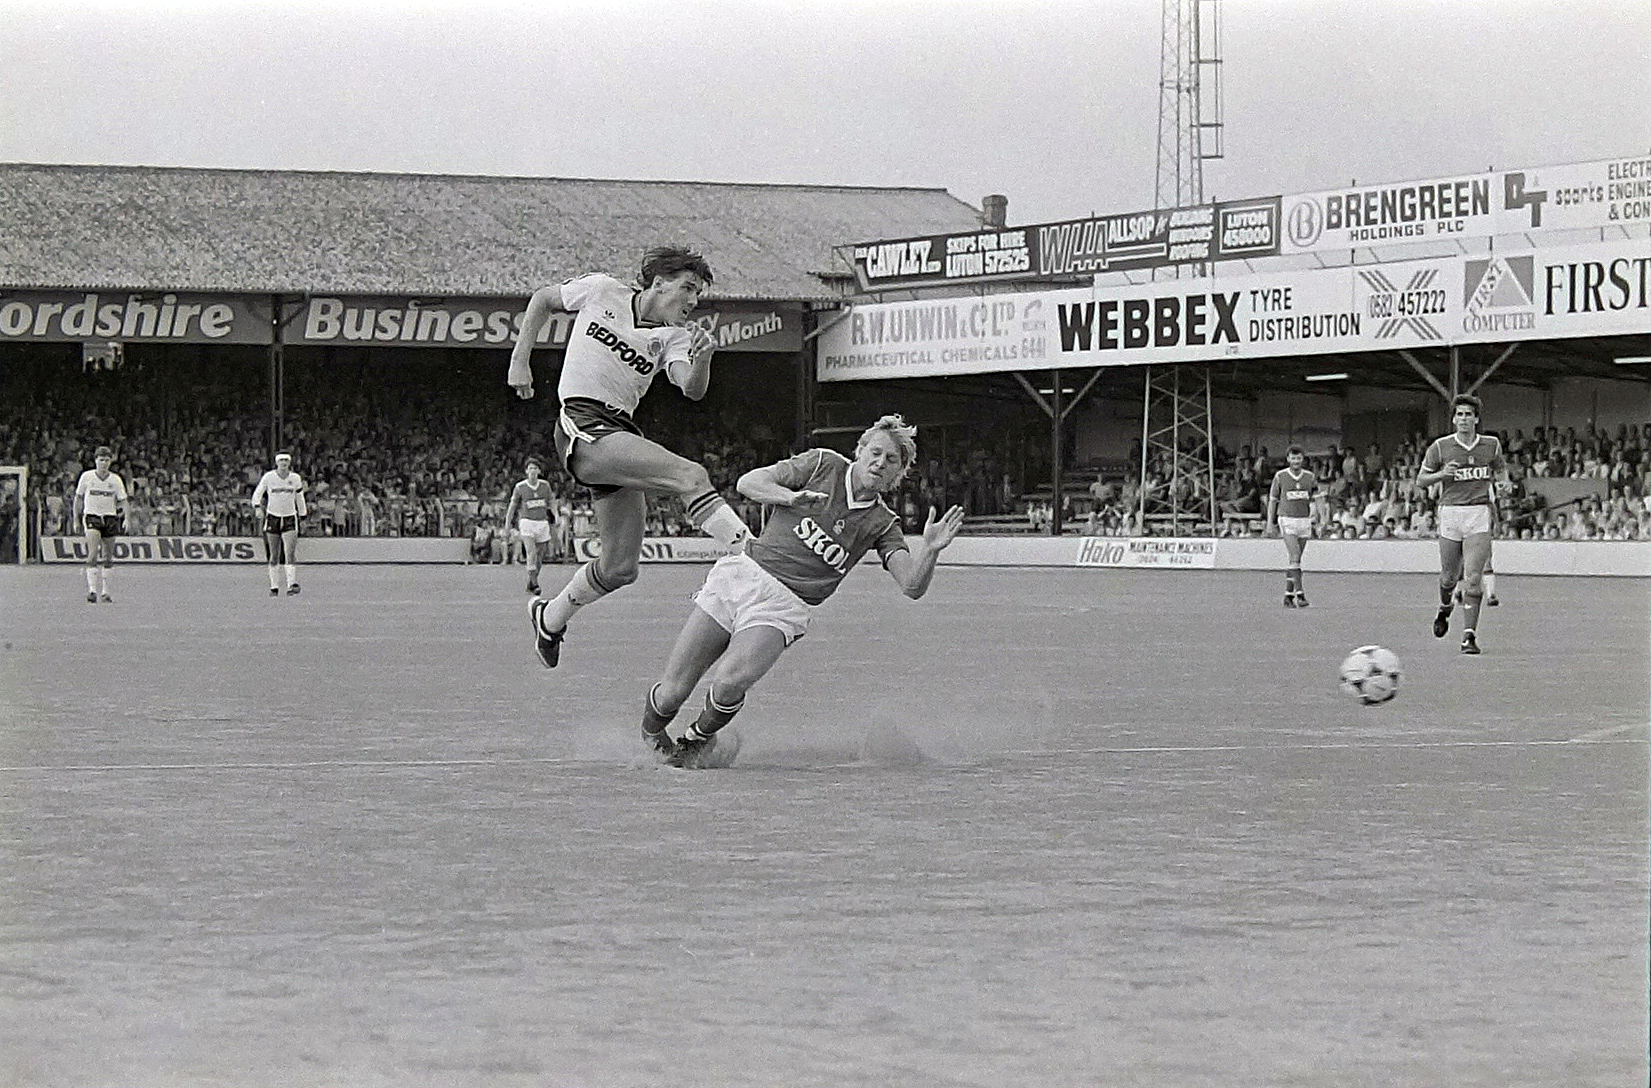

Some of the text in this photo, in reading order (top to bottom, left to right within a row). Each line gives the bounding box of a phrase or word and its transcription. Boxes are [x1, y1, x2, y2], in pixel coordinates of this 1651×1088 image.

[1326, 179, 1490, 230] BRENGREEN
[1608, 203, 1620, 221] &
[1107, 215, 1155, 244] ALLSOP
[1227, 211, 1269, 229] LUTON
[1350, 220, 1464, 241] HOLDINGS PLC
[946, 231, 1026, 254] SKIPS FOR HIRE
[866, 240, 932, 279] CAWLEY
[946, 252, 984, 278] LUTON
[1250, 287, 1292, 312] TYRE
[1544, 257, 1651, 315] FIRST
[0, 294, 234, 338] ordshire
[1397, 289, 1446, 316] 457222
[304, 298, 578, 344] Businessm
[720, 311, 783, 347] Month
[1057, 291, 1242, 353] WEBBEX
[1249, 312, 1361, 342] DISTRIBUTION
[1462, 311, 1536, 333] COMPUTER
[585, 321, 655, 376] BEDFORD
[825, 345, 1018, 370] PHARMACEUTICAL CHEMICALS
[53, 538, 255, 560] Luon News
[581, 538, 673, 560] Con
[792, 517, 850, 575] SKOL
[1079, 538, 1125, 564] Hako
